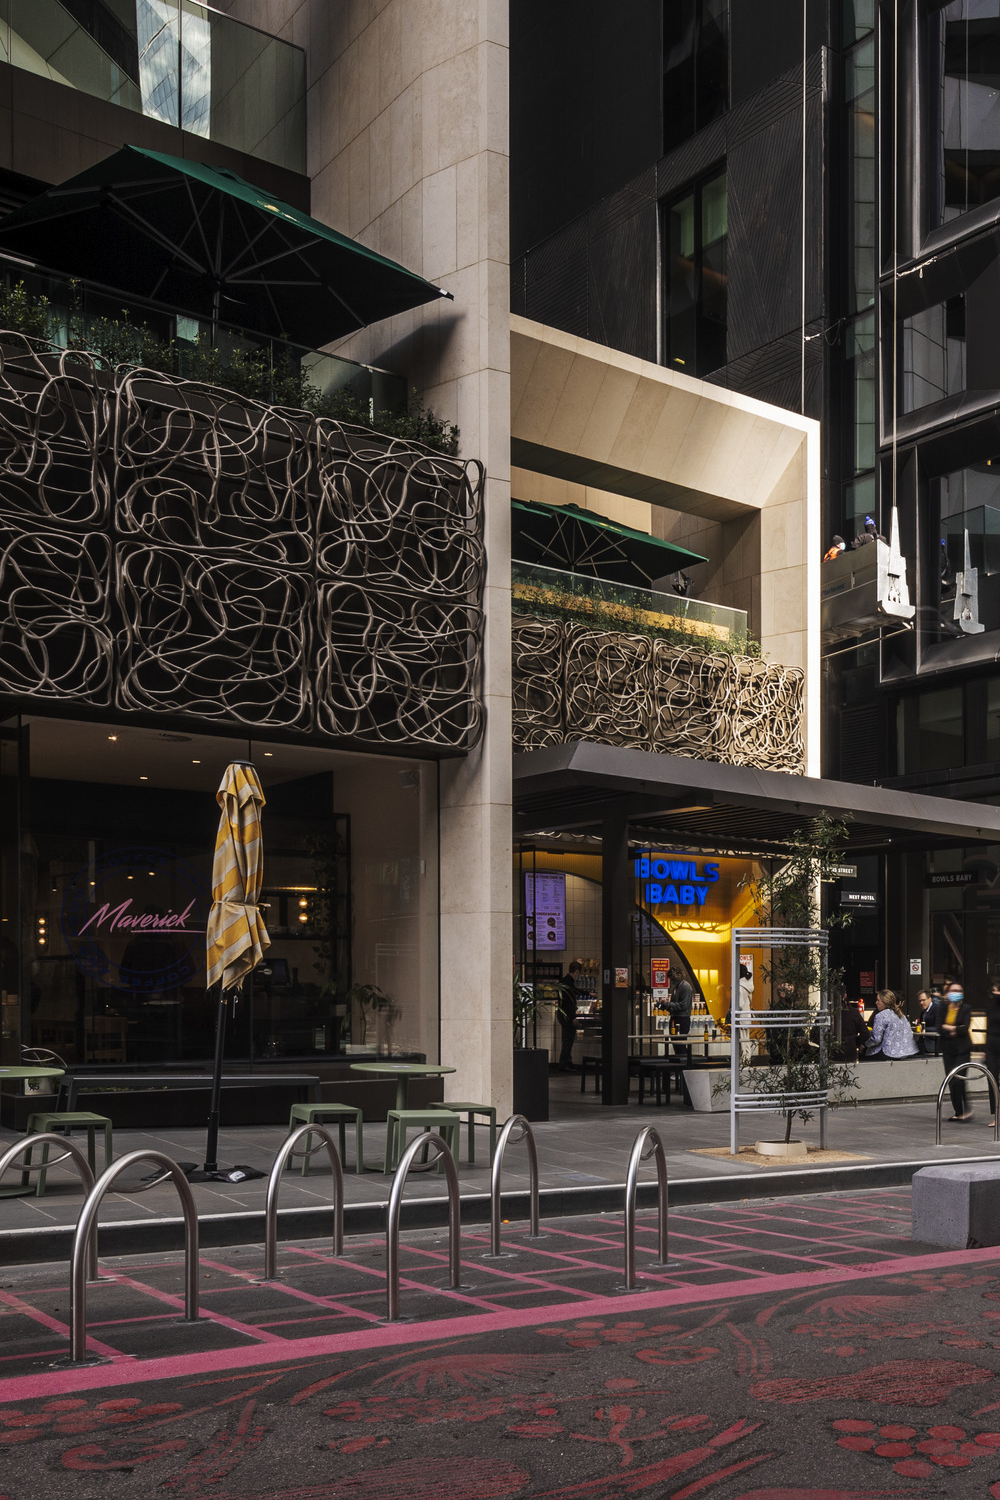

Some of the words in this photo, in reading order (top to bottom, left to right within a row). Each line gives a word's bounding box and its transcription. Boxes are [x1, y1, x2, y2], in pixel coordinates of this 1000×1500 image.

[635, 858, 719, 882] BOWLS
[645, 883, 709, 905] BABY
[78, 898, 197, 937] Maverick
